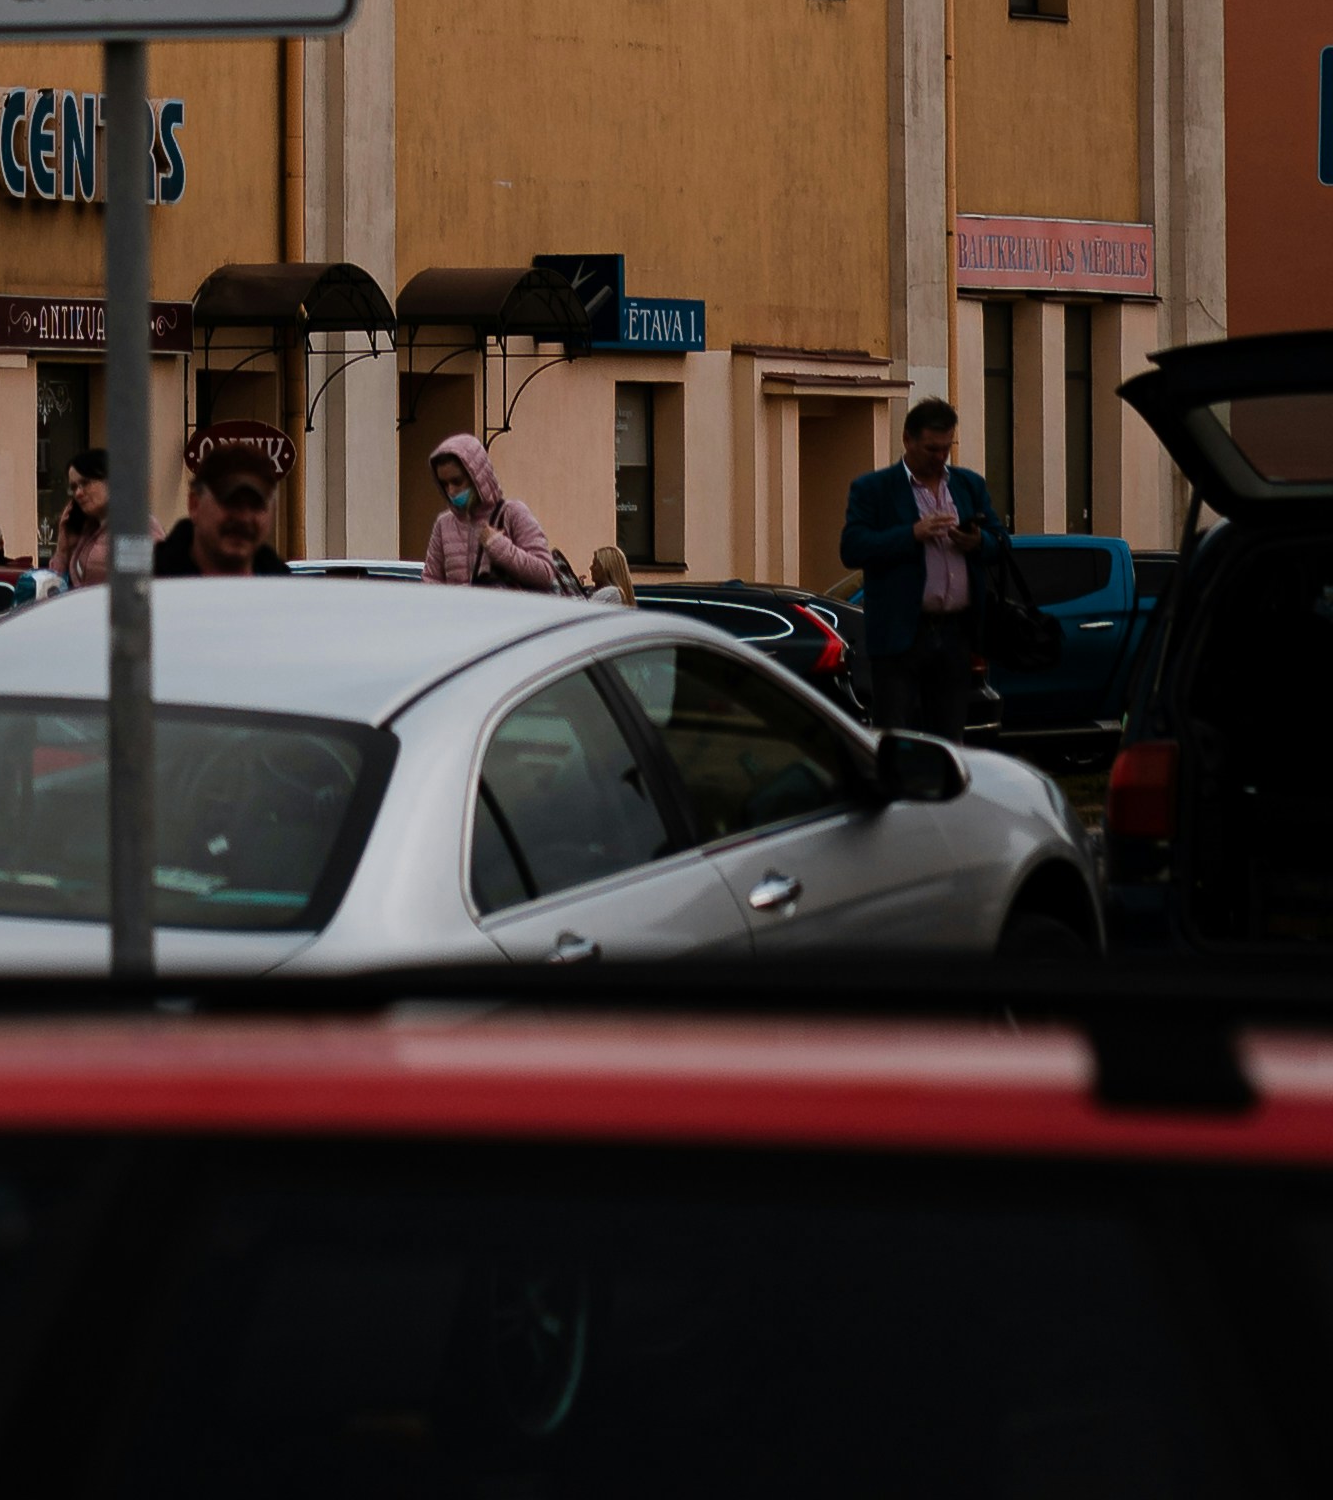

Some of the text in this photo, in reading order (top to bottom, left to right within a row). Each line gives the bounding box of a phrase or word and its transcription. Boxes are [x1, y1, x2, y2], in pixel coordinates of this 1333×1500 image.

[0, 87, 186, 205] CENS
[957, 233, 1149, 281] BALTKRIEVIJAS MĒBELES
[624, 302, 684, 342] ĒTAVA
